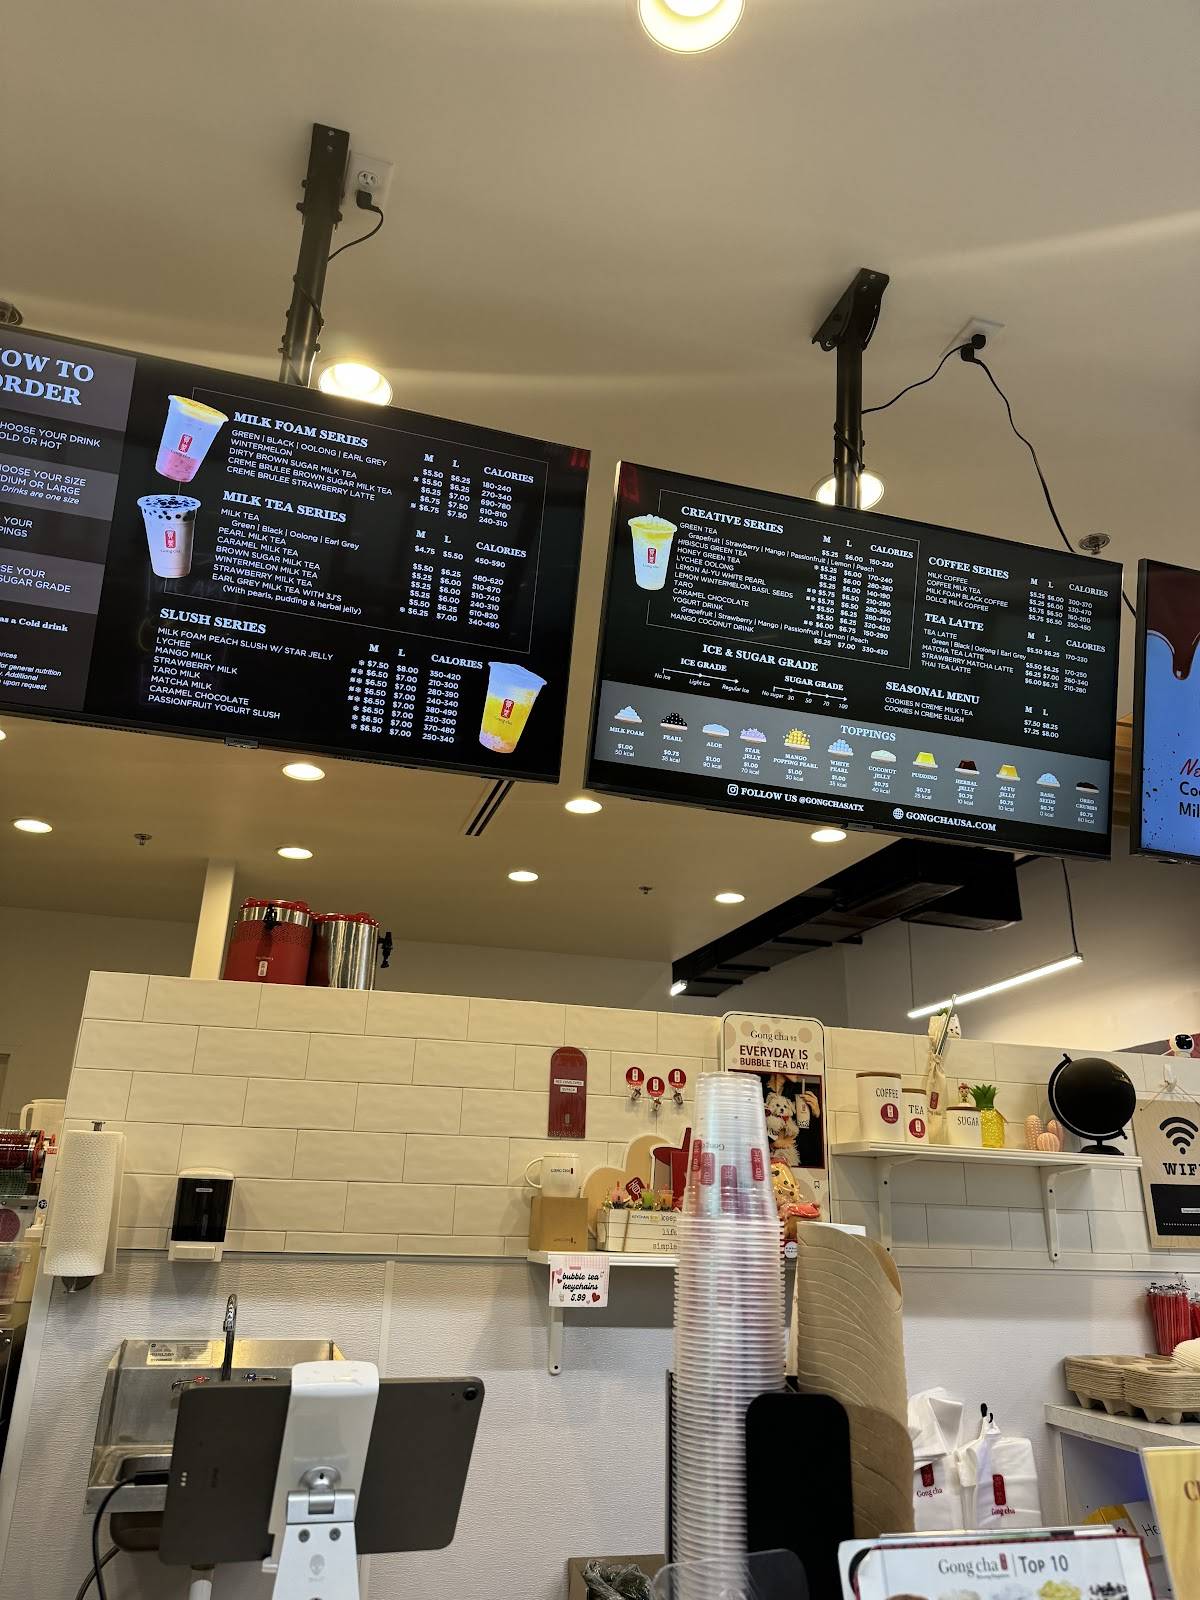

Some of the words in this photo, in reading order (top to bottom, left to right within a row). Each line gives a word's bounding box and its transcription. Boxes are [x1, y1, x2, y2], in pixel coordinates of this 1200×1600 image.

[0, 348, 50, 372] OW
[56, 359, 93, 381] TO
[0, 421, 36, 434] HOOSE
[38, 428, 67, 440] YOUR
[69, 434, 100, 447] DRINK
[233, 411, 271, 428] MILK
[274, 419, 316, 437] FOAM
[319, 429, 367, 447] SERIES
[0, 431, 19, 441] OLD
[22, 435, 37, 445] OR
[39, 438, 61, 449] HOT
[230, 438, 292, 456] WINTERMELON
[0, 464, 30, 476] OOSE
[33, 470, 62, 481] YOUR
[64, 475, 86, 486] SIZE
[423, 453, 433, 462] M
[452, 459, 459, 467] L
[483, 466, 533, 483] CALORIES
[0, 474, 26, 485] DIUM
[226, 465, 255, 476] CREME
[257, 471, 289, 483] BRULEE
[291, 478, 348, 494] STRAWBERRY
[349, 490, 375, 500] LATTE
[1, 484, 28, 495] Drinks
[62, 496, 79, 504] size
[220, 508, 240, 517] MILK
[243, 512, 259, 521] TEA
[222, 490, 261, 506] MILK
[264, 498, 293, 512] TEA
[296, 504, 346, 522] SERIES
[3, 516, 32, 528] YOUR
[681, 506, 741, 525] CREATIVE
[743, 518, 783, 533] SERIES
[218, 526, 245, 537] PEARL
[248, 531, 267, 541] MILK
[270, 535, 286, 544] TEA
[215, 545, 249, 556] BROWN
[251, 551, 280, 562] SUGAR
[282, 557, 301, 566] MILK
[304, 560, 320, 570] TEA
[677, 546, 701, 556] HONEY
[702, 551, 725, 560] GREEN
[727, 555, 740, 563] TEA
[870, 544, 913, 558] CALORIES
[16, 566, 45, 578] YOUR
[928, 556, 970, 571] COFFEE
[972, 564, 1008, 579] SERIES
[0, 574, 32, 586] SUGAR
[35, 580, 70, 592] GRADE
[673, 579, 693, 588] TARO
[926, 579, 951, 589] COFFEE
[672, 596, 700, 606] YOGURT
[702, 601, 723, 610] DRINK
[159, 607, 211, 625] SLUSH
[213, 616, 266, 633] SERIES
[924, 612, 946, 624] TEA
[948, 617, 983, 631] LATTE
[156, 636, 190, 648] LYCHEE
[153, 655, 215, 670] STRAWBERRY
[216, 665, 237, 674] MILK
[430, 654, 482, 669] CALORIES
[680, 657, 695, 666] ICE
[696, 660, 726, 671] GRADE
[702, 643, 722, 655] ICE
[724, 648, 733, 657] &
[735, 649, 775, 664] SUGAR
[777, 657, 818, 671] GRADE
[152, 665, 177, 675] TARO
[179, 669, 200, 678] MILK
[921, 659, 936, 667] THAI
[950, 664, 970, 673] LATTE
[150, 675, 188, 686] MATCHA
[190, 680, 211, 690] MILK
[784, 675, 813, 686] SUGAR
[814, 680, 843, 690] GRADE
[149, 684, 192, 697] CARAMEL
[194, 691, 249, 705] CHOCOLATE
[885, 681, 944, 698] SEASONAL
[946, 690, 979, 704] MENU
[148, 694, 212, 709] PASSIONFRUIT
[214, 703, 250, 714] YOGURT
[252, 708, 280, 718] SLUSH
[840, 724, 895, 741] TOPPINGS
[740, 787, 782, 800] FOLLOW
[784, 793, 797, 802] US
[798, 796, 863, 811] @GONGCHASATX
[905, 811, 996, 831] GONGCHAUSA.COM
[750, 1030, 772, 1042] Gong
[774, 1032, 788, 1040] cha
[740, 1045, 795, 1059] EVERYDAY
[799, 1050, 808, 1060] IS
[740, 1058, 771, 1067] BUBBLE
[773, 1060, 788, 1068] TEA
[876, 1088, 898, 1098] COFFEE
[908, 1104, 924, 1114] TEA
[958, 1116, 979, 1126] SUGAR
[1162, 1162, 1200, 1176] WIF
[562, 1282, 598, 1292] keychains
[570, 1294, 586, 1302] 5.99
[916, 1489, 933, 1497] Gong
[1004, 1506, 1016, 1515] cha
[938, 1558, 974, 1576] Gong
[976, 1556, 999, 1572] cha
[1051, 1554, 1068, 1572] 10
